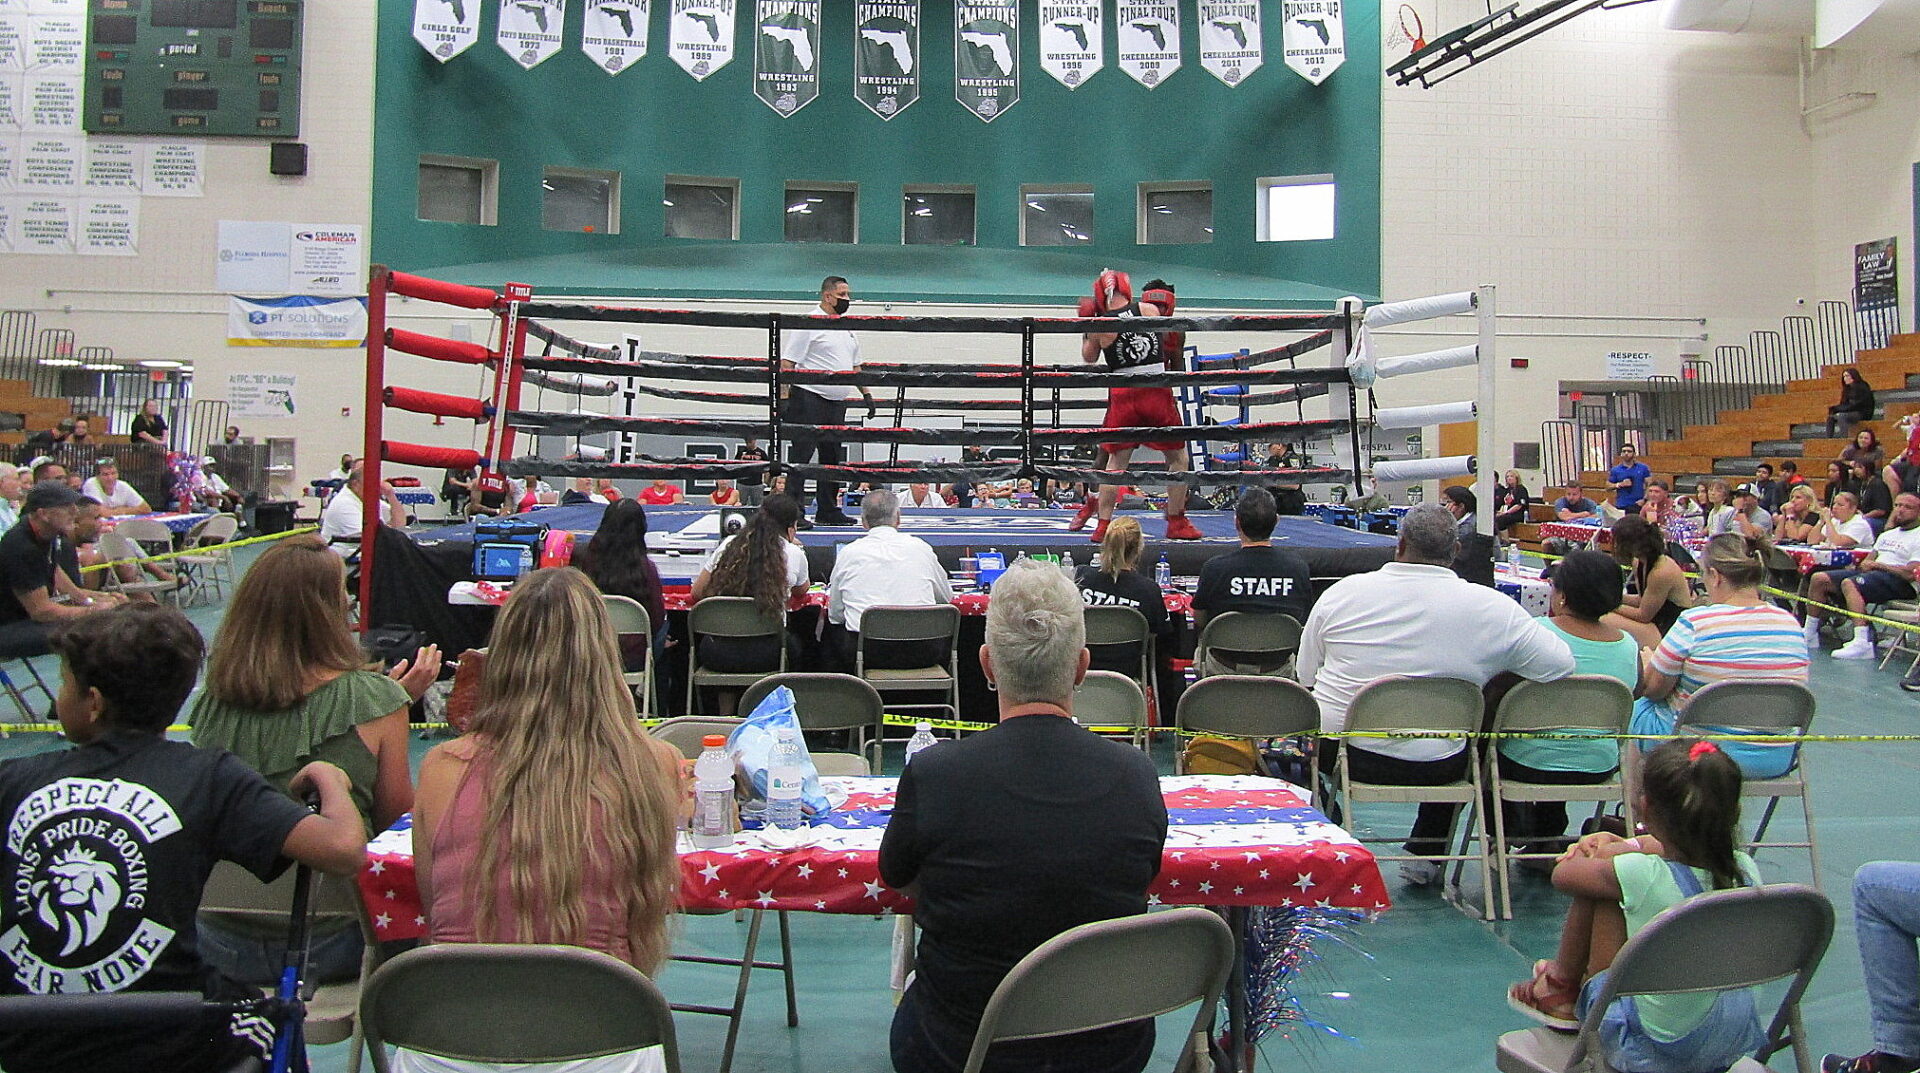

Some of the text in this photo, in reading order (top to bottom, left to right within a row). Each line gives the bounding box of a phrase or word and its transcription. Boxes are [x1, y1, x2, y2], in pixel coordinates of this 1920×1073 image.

[759, 1, 817, 23] CHAMPIONS
[859, 5, 916, 27] CHAMPIONS
[1043, 7, 1099, 26] RUNNER-UP
[1120, 7, 1177, 27] FINAL FOUR
[1201, 6, 1257, 25] FINAL FOUR
[1285, 2, 1339, 22] RUNNER-UP
[959, 7, 1016, 29] CHAMPIONS
[422, 23, 472, 34] GIRLS GOLF
[500, 31, 561, 42] BOYS BASKETBALL
[585, 37, 646, 48] BOYS BASKETBALL
[676, 43, 727, 52] WRESTLING
[169, 43, 197, 55] period
[1286, 48, 1342, 57] CHEERLEADING
[1203, 51, 1260, 59] CHEERLEADING
[1305, 57, 1325, 65] 2012
[759, 72, 815, 82] WRESTLING
[859, 76, 915, 85] WRESTLING
[776, 83, 797, 91] 1993
[959, 79, 1015, 87] WRESTLING
[876, 86, 897, 95] 1994
[1857, 252, 1884, 264] FAMILY
[1863, 261, 1879, 270] LAW
[271, 314, 349, 323] PT SOLUTIONS
[1230, 577, 1293, 596] STAFF
[10, 783, 169, 848] RESPECT ALL
[42, 817, 112, 848] PRIDE
[108, 828, 149, 911] BOXING
[11, 930, 161, 994] FEAR NONE
